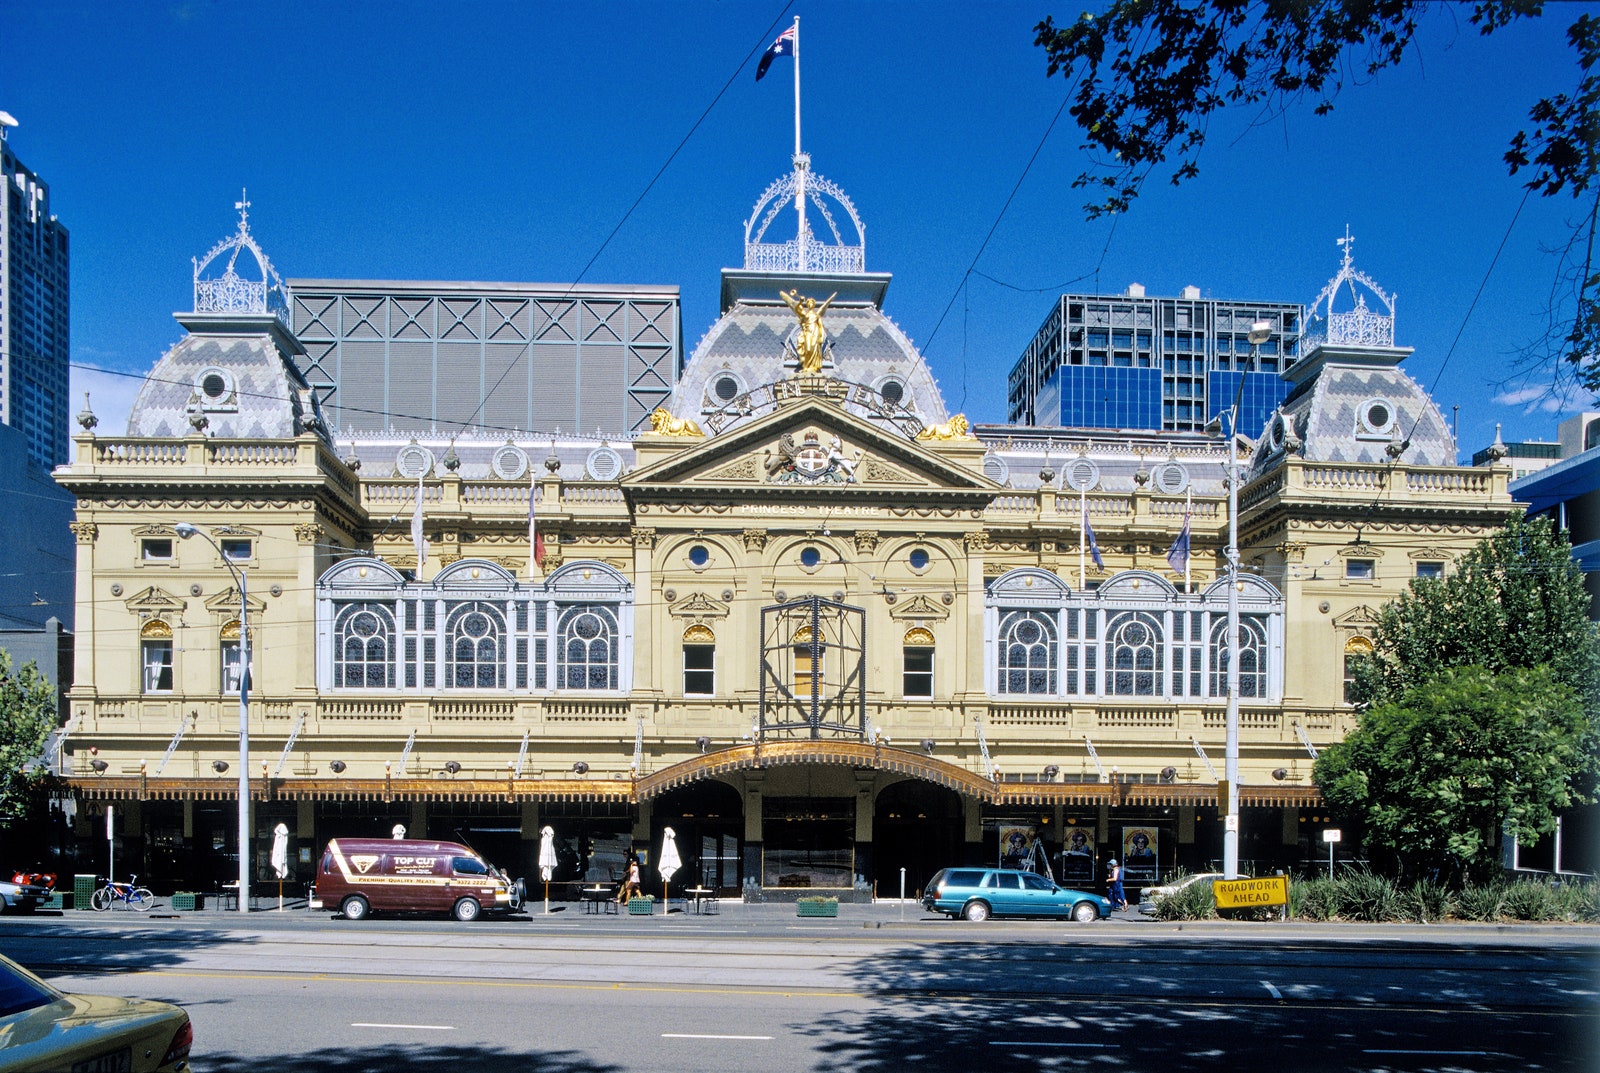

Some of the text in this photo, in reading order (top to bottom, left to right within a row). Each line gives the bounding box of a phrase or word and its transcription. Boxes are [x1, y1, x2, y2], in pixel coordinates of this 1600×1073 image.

[741, 504, 880, 516] PRINCESS' THEATRE
[394, 857, 437, 865] TOP CUT
[1220, 881, 1278, 892] ROADWORK
[1233, 893, 1269, 903] AHEAD
